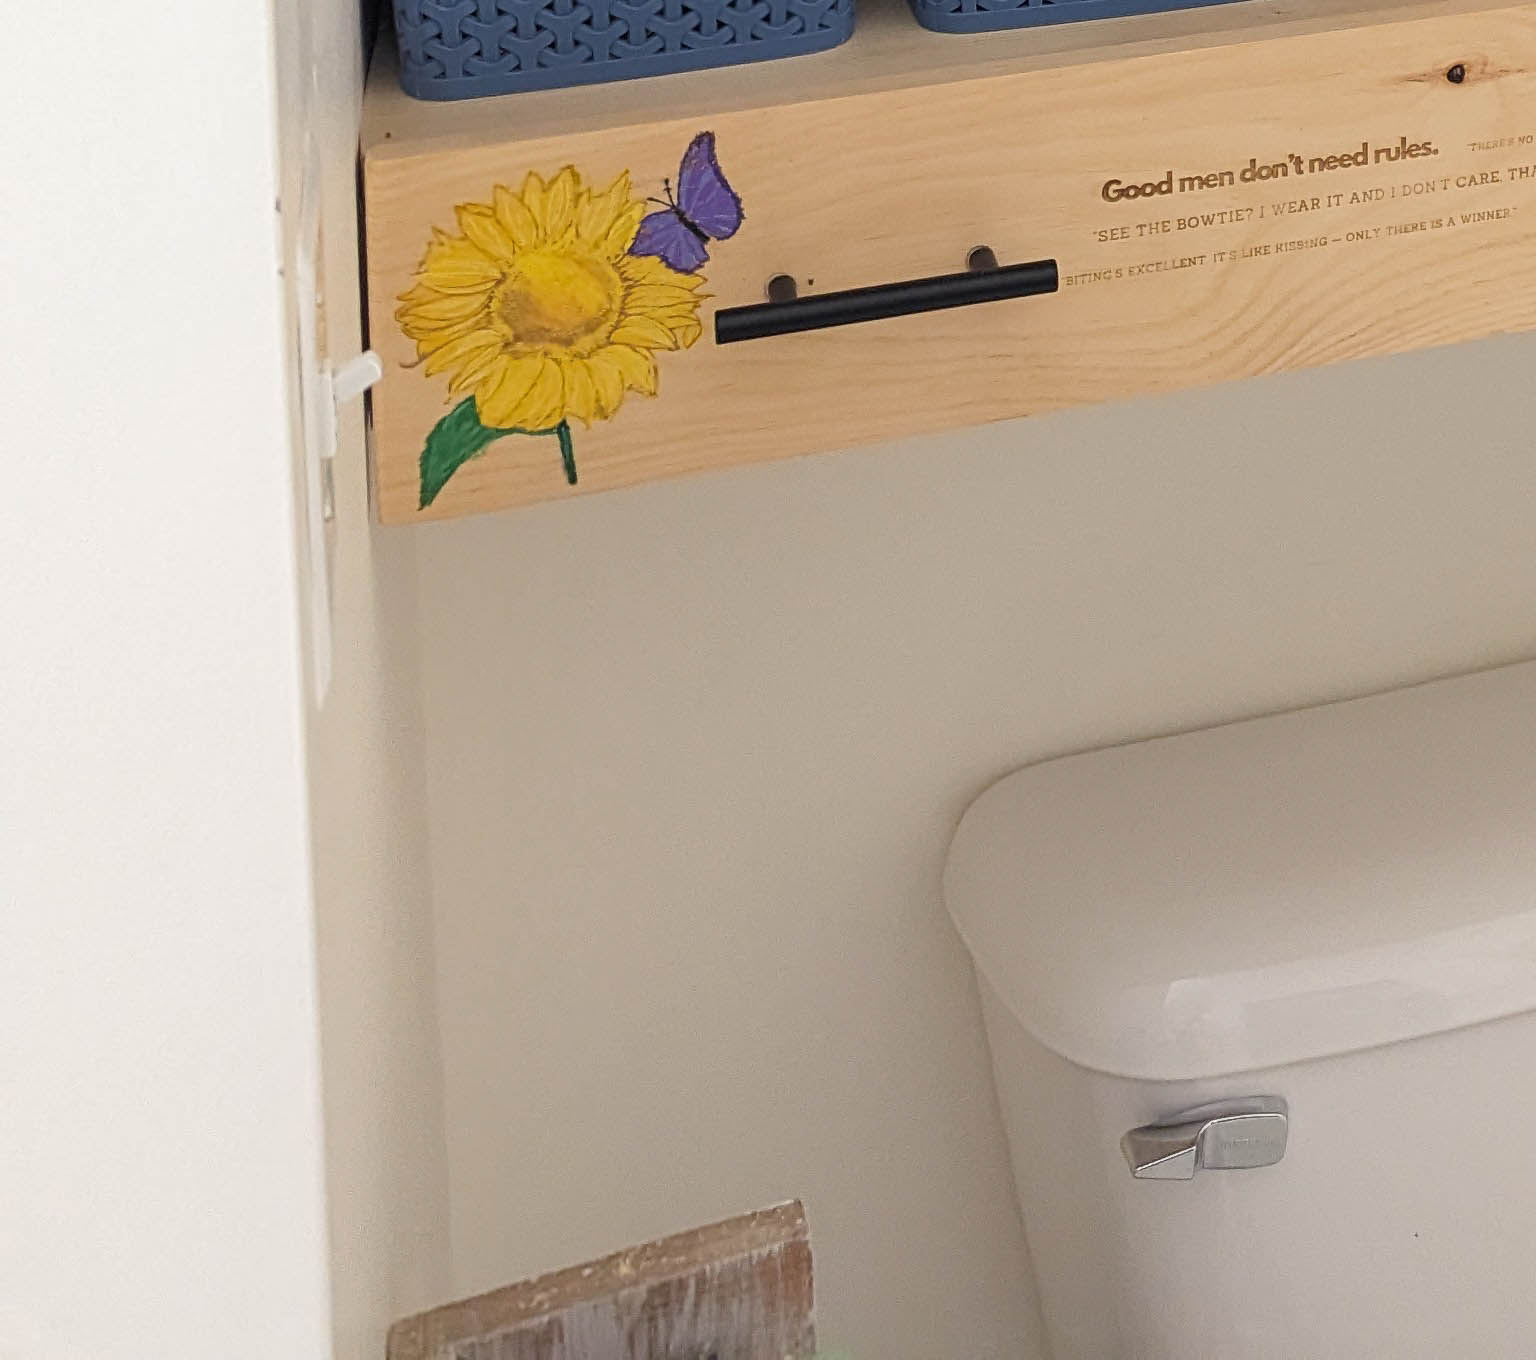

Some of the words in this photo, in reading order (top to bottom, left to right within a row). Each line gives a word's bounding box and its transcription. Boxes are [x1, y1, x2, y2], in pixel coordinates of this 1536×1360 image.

[1518, 134, 1534, 145] NO
[1101, 170, 1174, 202] Good
[1178, 170, 1235, 193] men
[1308, 141, 1369, 174] need
[1373, 135, 1439, 165] rules.
[1136, 220, 1171, 237] THE
[1176, 207, 1254, 231] BOWTIE?
[1258, 205, 1265, 219] I
[1271, 197, 1322, 217] WEAR
[1326, 193, 1344, 208] IT
[1349, 188, 1386, 205] AND
[1390, 186, 1396, 200] I
[1241, 244, 1272, 259] LIKE
[1275, 236, 1328, 254] KISSING
[1345, 228, 1382, 243] ONLY
[1385, 220, 1428, 237] THERE
[1430, 218, 1444, 229] IS
[1447, 216, 1457, 227] A
